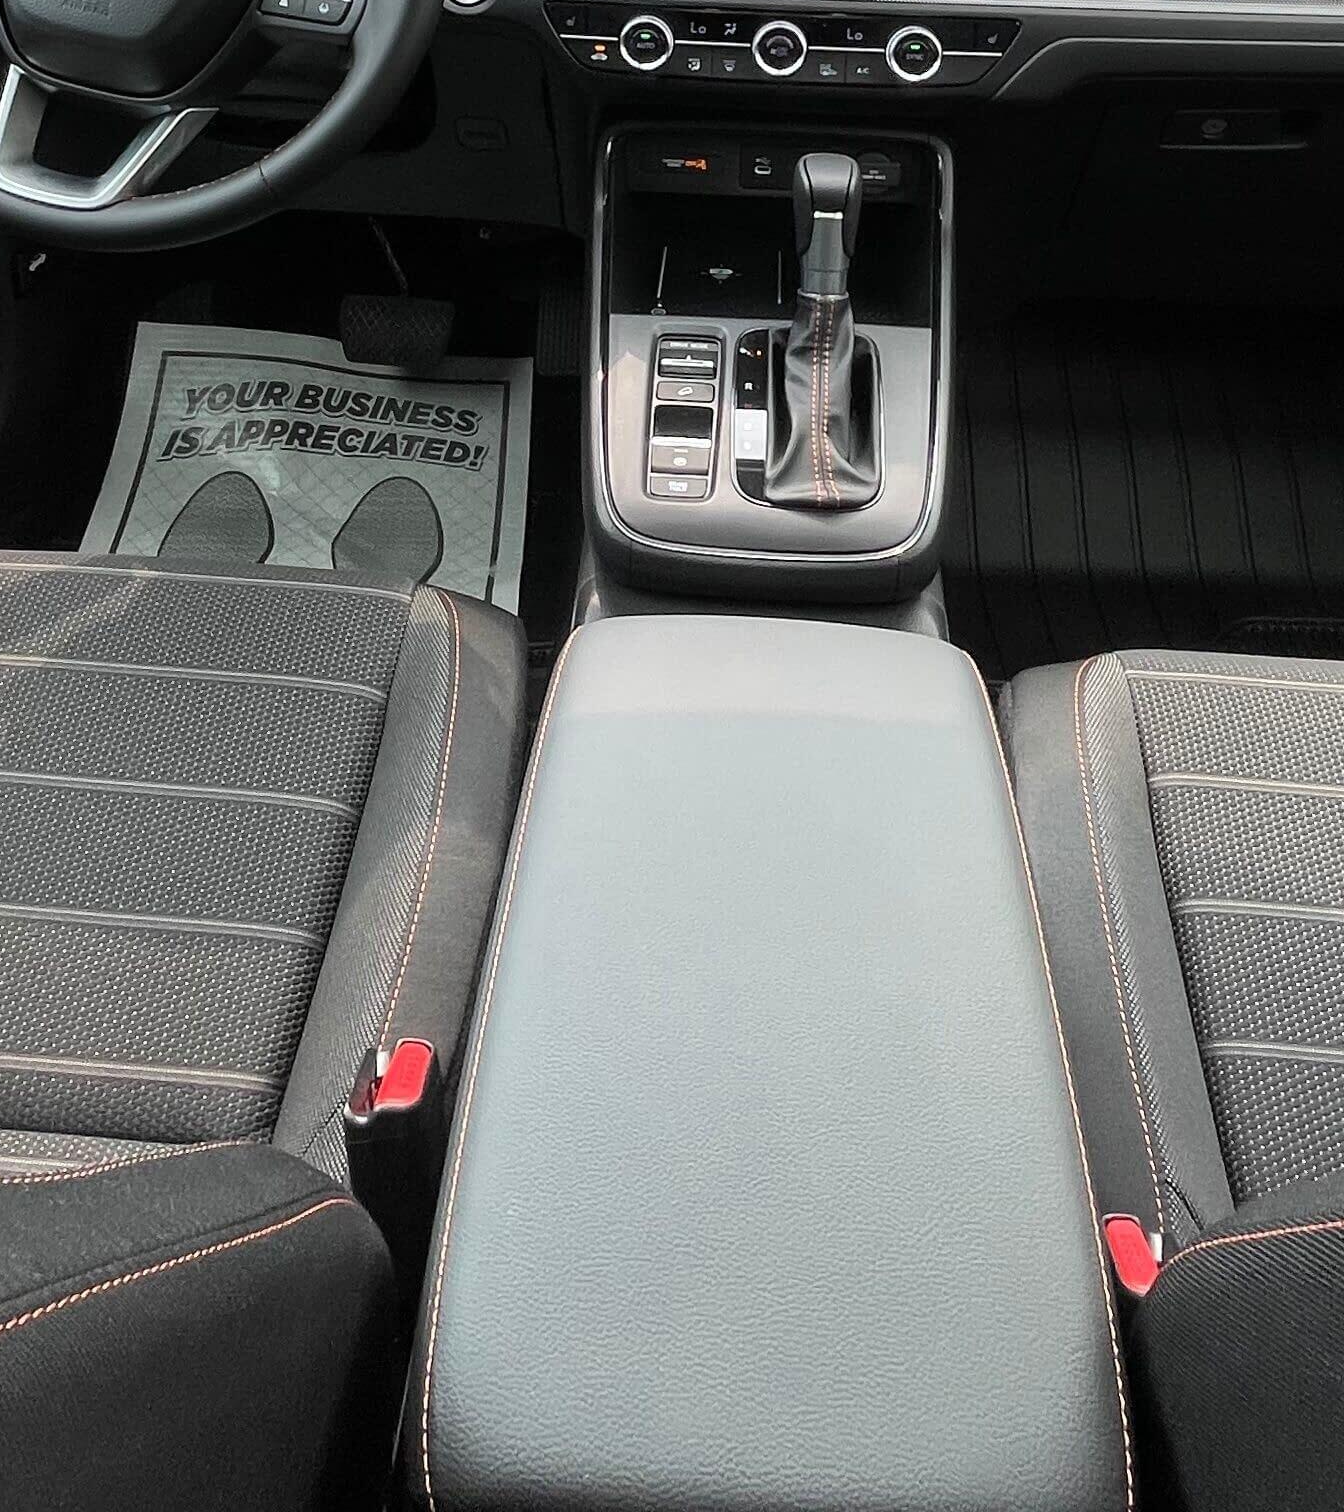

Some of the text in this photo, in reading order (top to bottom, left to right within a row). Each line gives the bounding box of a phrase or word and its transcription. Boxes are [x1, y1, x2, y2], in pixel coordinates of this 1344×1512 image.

[184, 380, 482, 434] YOUR BUSINESS
[160, 419, 487, 469] IS APPRECIATED!
